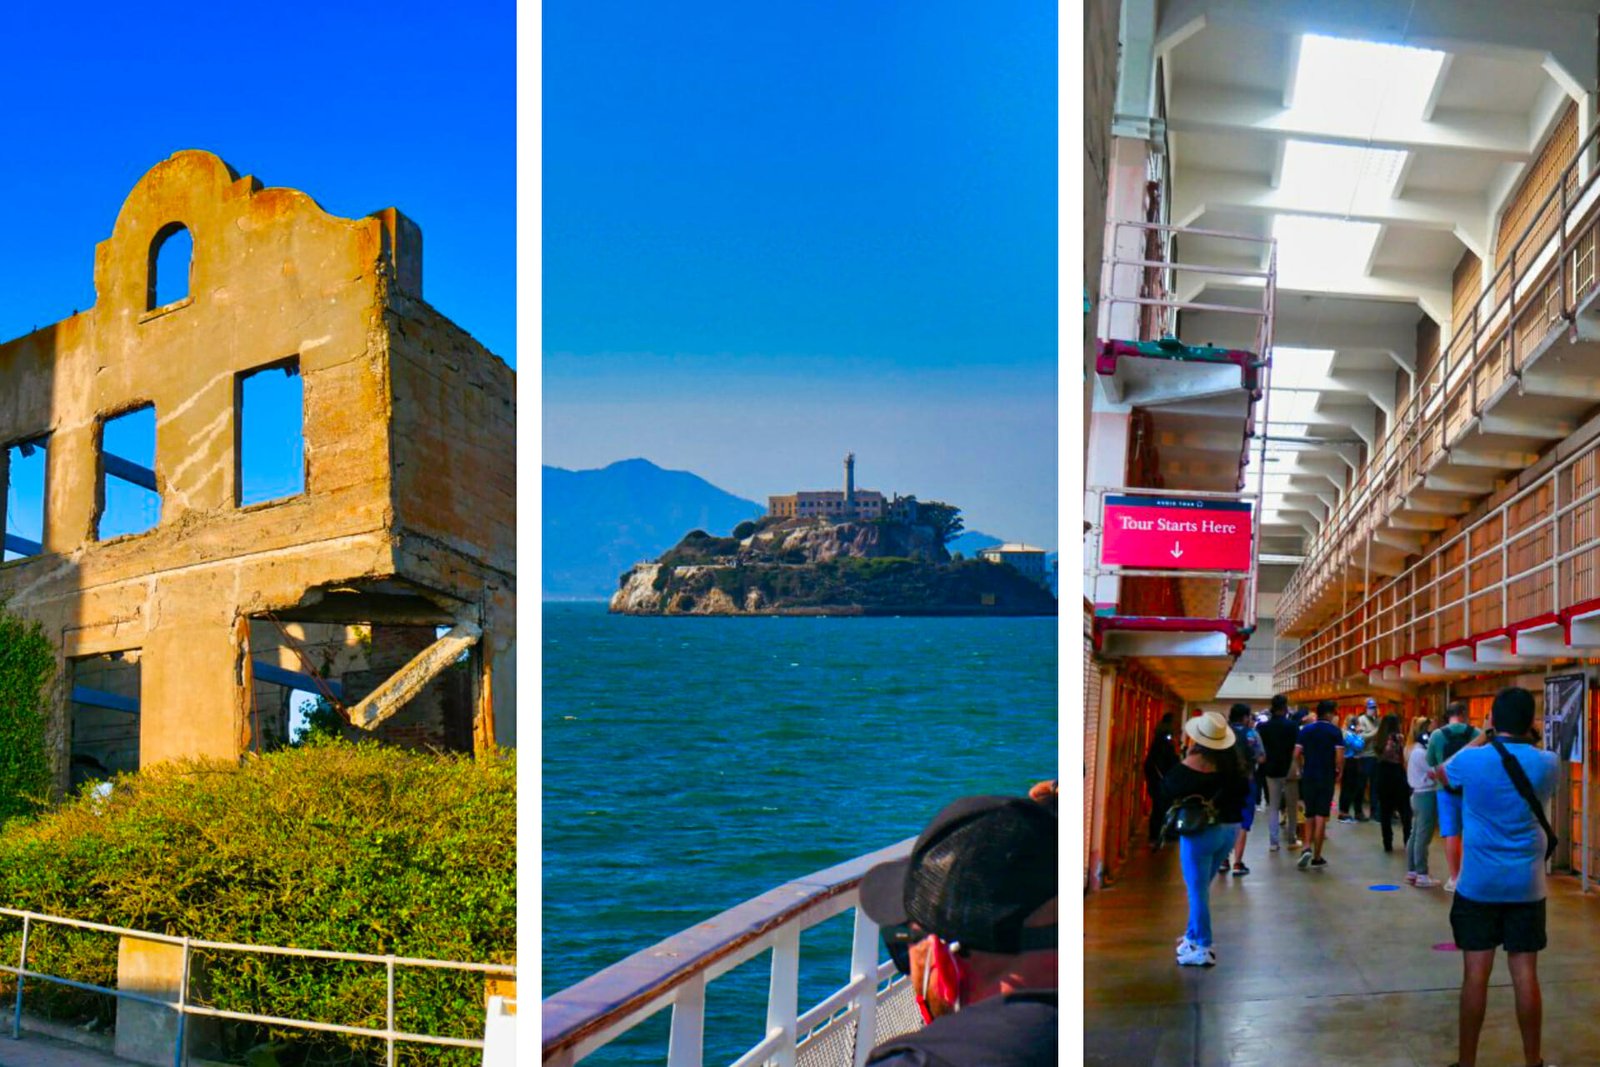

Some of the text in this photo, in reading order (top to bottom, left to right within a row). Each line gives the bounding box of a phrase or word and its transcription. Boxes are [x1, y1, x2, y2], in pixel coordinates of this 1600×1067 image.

[1119, 515, 1236, 534] Tour Starts Here
